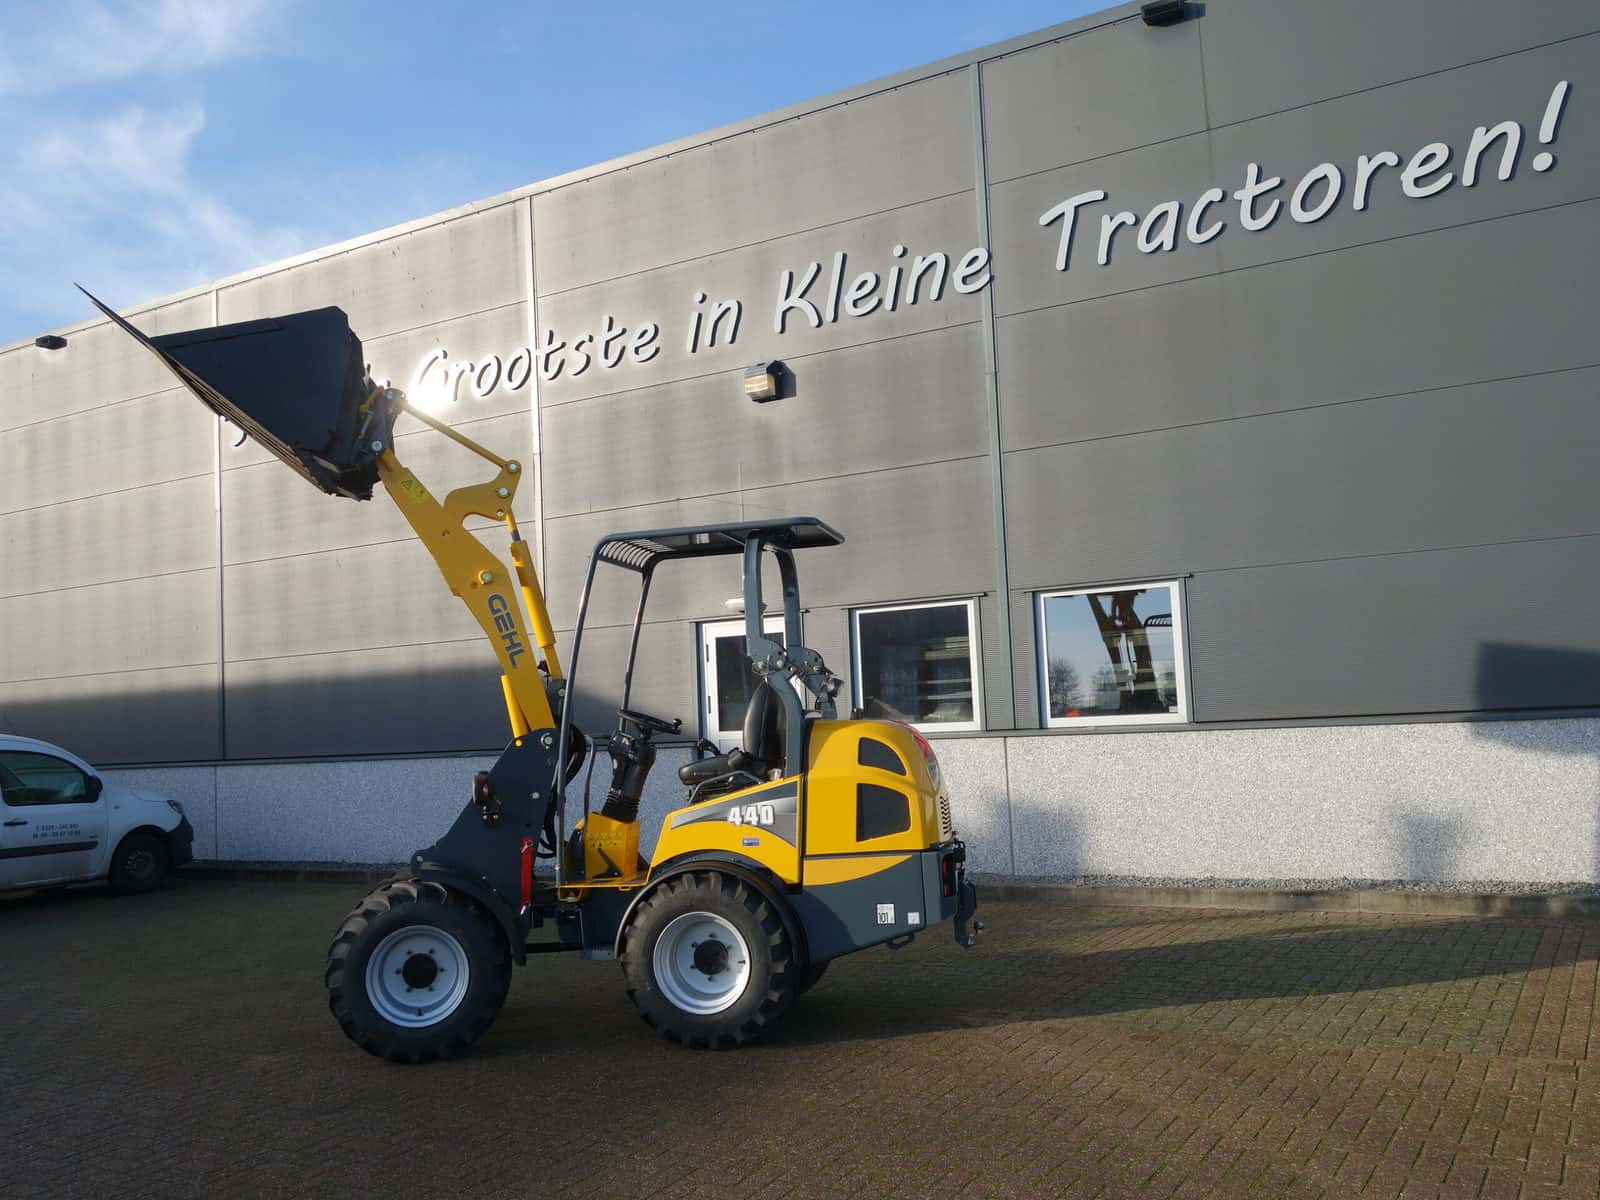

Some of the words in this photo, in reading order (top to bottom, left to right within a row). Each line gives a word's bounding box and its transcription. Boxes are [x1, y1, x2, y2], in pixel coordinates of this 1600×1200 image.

[688, 292, 742, 354] in
[773, 244, 992, 334] Kleine
[1039, 81, 1570, 271] Tractoren!
[488, 594, 525, 670] GEHL
[728, 804, 775, 826] 440
